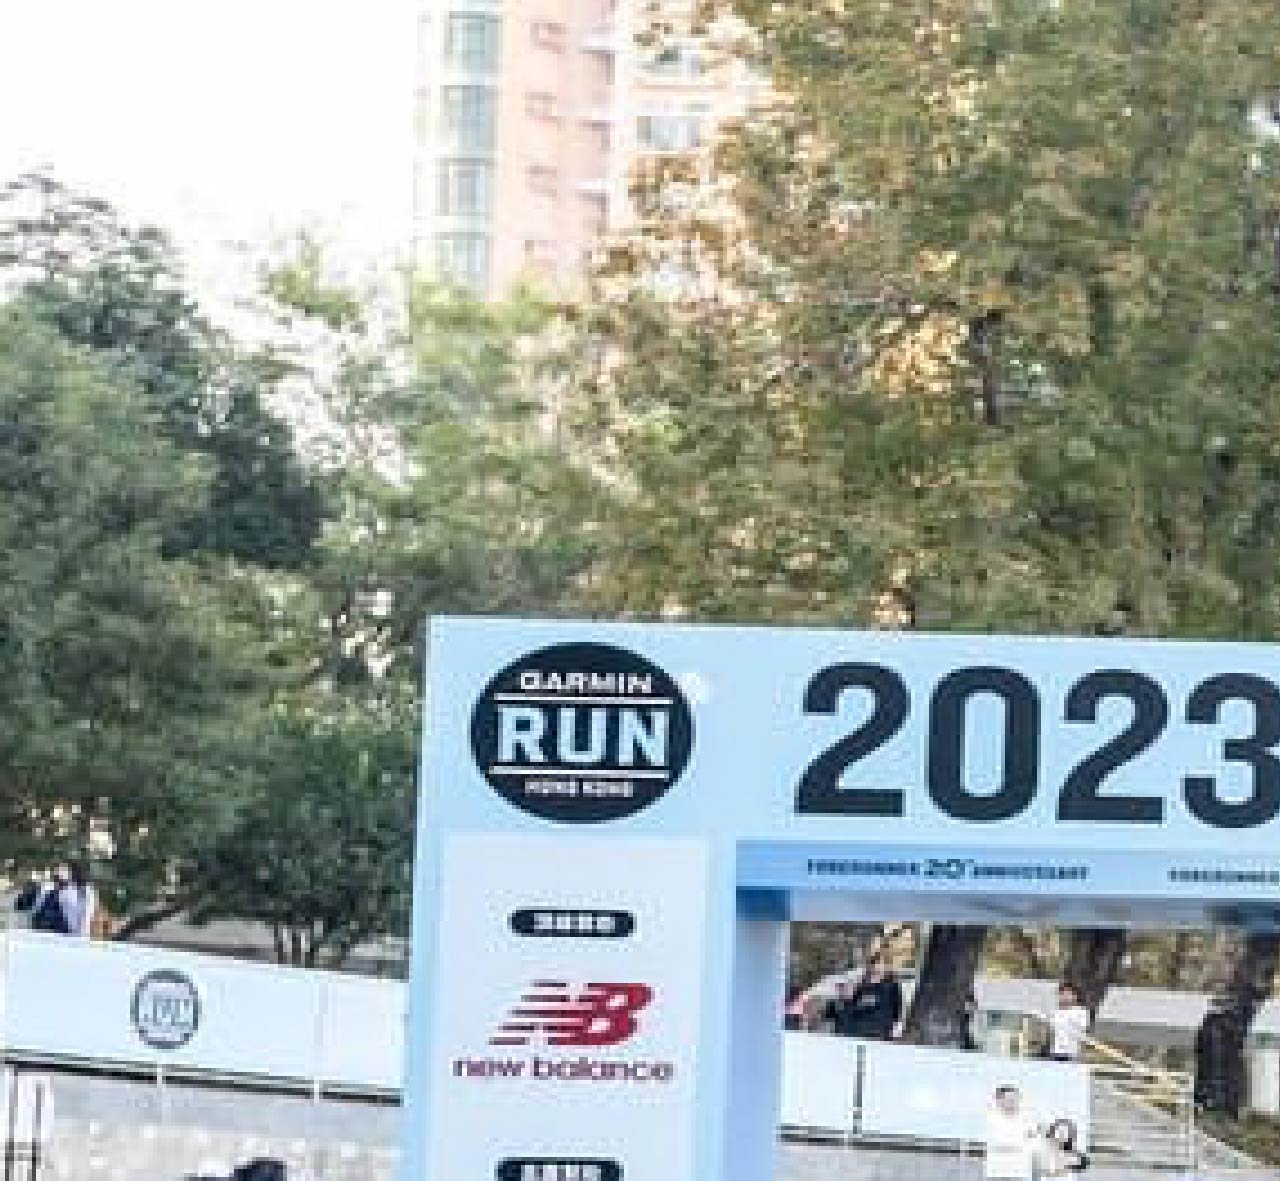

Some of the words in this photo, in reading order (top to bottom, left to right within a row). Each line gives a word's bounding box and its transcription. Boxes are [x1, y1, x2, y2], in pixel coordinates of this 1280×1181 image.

[519, 670, 653, 695] GARMIN
[495, 705, 671, 768] RUN
[452, 1057, 525, 1082] new
[531, 1056, 675, 1082] balance
